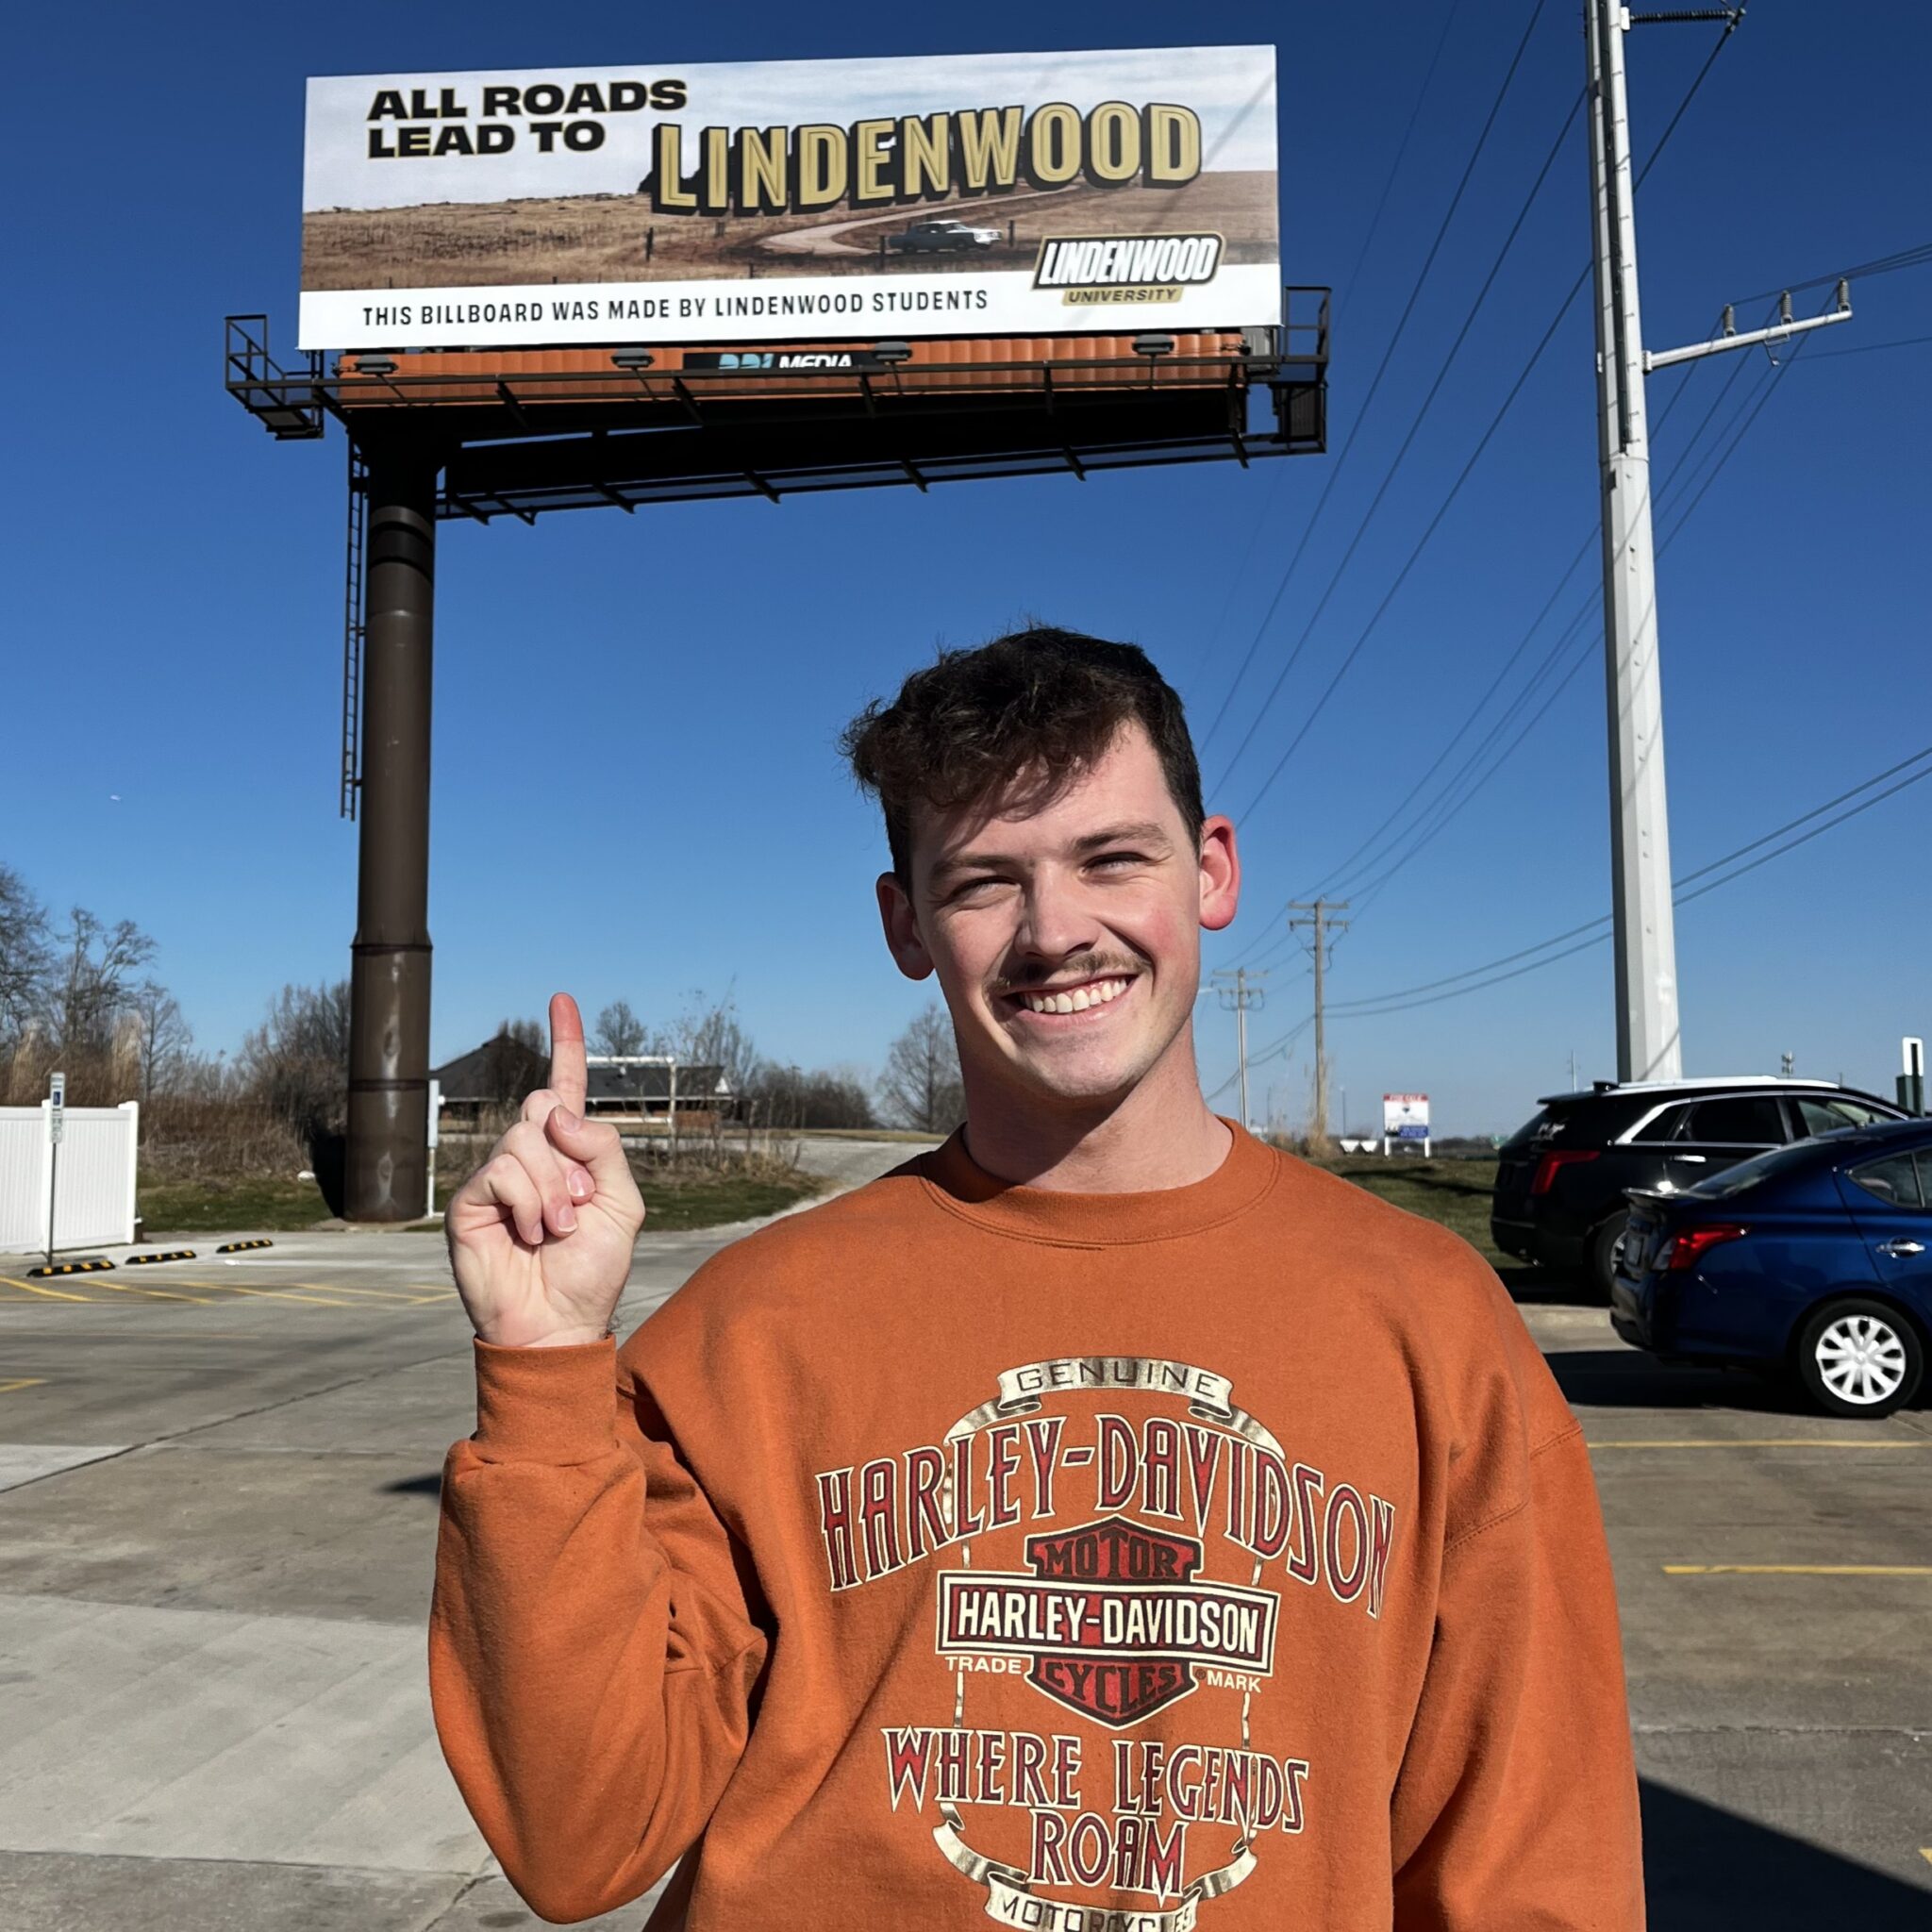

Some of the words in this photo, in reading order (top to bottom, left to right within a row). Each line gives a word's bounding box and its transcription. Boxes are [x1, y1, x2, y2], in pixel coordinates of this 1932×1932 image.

[367, 88, 467, 121] ALL
[482, 79, 688, 116] ROADS
[368, 125, 516, 158] LEAD
[530, 121, 606, 153] TO
[651, 100, 1203, 216] LINDENWOOD
[1039, 238, 1219, 285] LINDENWOOD
[363, 307, 411, 325] THIS
[421, 303, 543, 324] BILLBOARD
[553, 301, 599, 321] WAS
[608, 299, 670, 319] MADE
[679, 298, 706, 317] BY
[715, 293, 863, 316] LINDENWOOD
[873, 290, 988, 312] STUDENTS
[1069, 289, 1177, 303] UNIVERSITY
[779, 354, 852, 368] MEDIA
[1016, 1361, 1221, 1398] GENUINE
[815, 1413, 1396, 1620] HARLEY-DAVIDSON
[1043, 1524, 1181, 1579] MOTOR
[957, 1591, 1259, 1655] HARLEY-DAVIDSON
[945, 1656, 1022, 1675] TRADE
[1044, 1662, 1177, 1713] CYCLES
[880, 1724, 1081, 1814] WHERE
[1111, 1739, 1310, 1844] LEGENDS
[1028, 1807, 1190, 1909] ROAM
